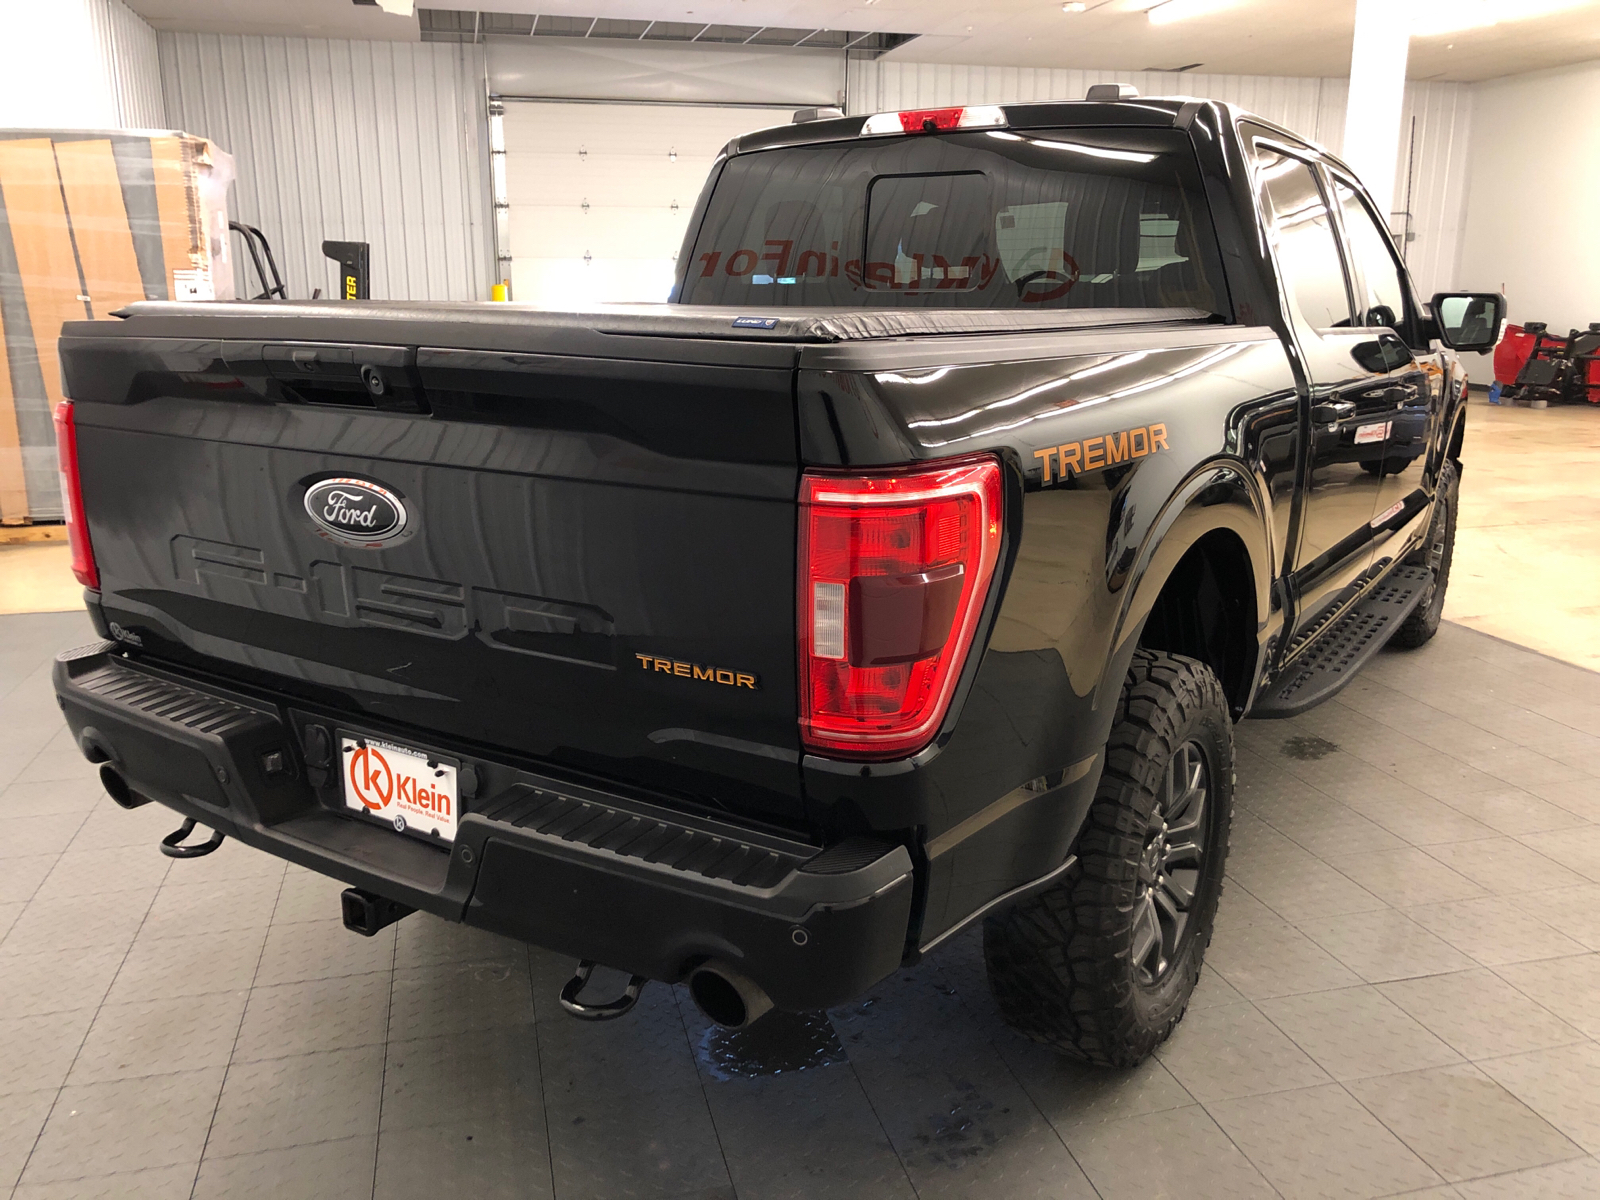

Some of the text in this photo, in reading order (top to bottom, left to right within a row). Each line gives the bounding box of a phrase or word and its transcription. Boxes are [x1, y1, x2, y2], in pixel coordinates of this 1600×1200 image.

[346, 275, 357, 300] TER
[1033, 422, 1170, 482] TREMOR
[323, 490, 378, 528] Ford
[170, 533, 618, 671] F-150
[635, 652, 756, 690] TREMOR
[364, 738, 428, 760] www.kleinauto.com
[396, 773, 451, 816] Klein
[397, 802, 451, 824] Real People. Real Value.
